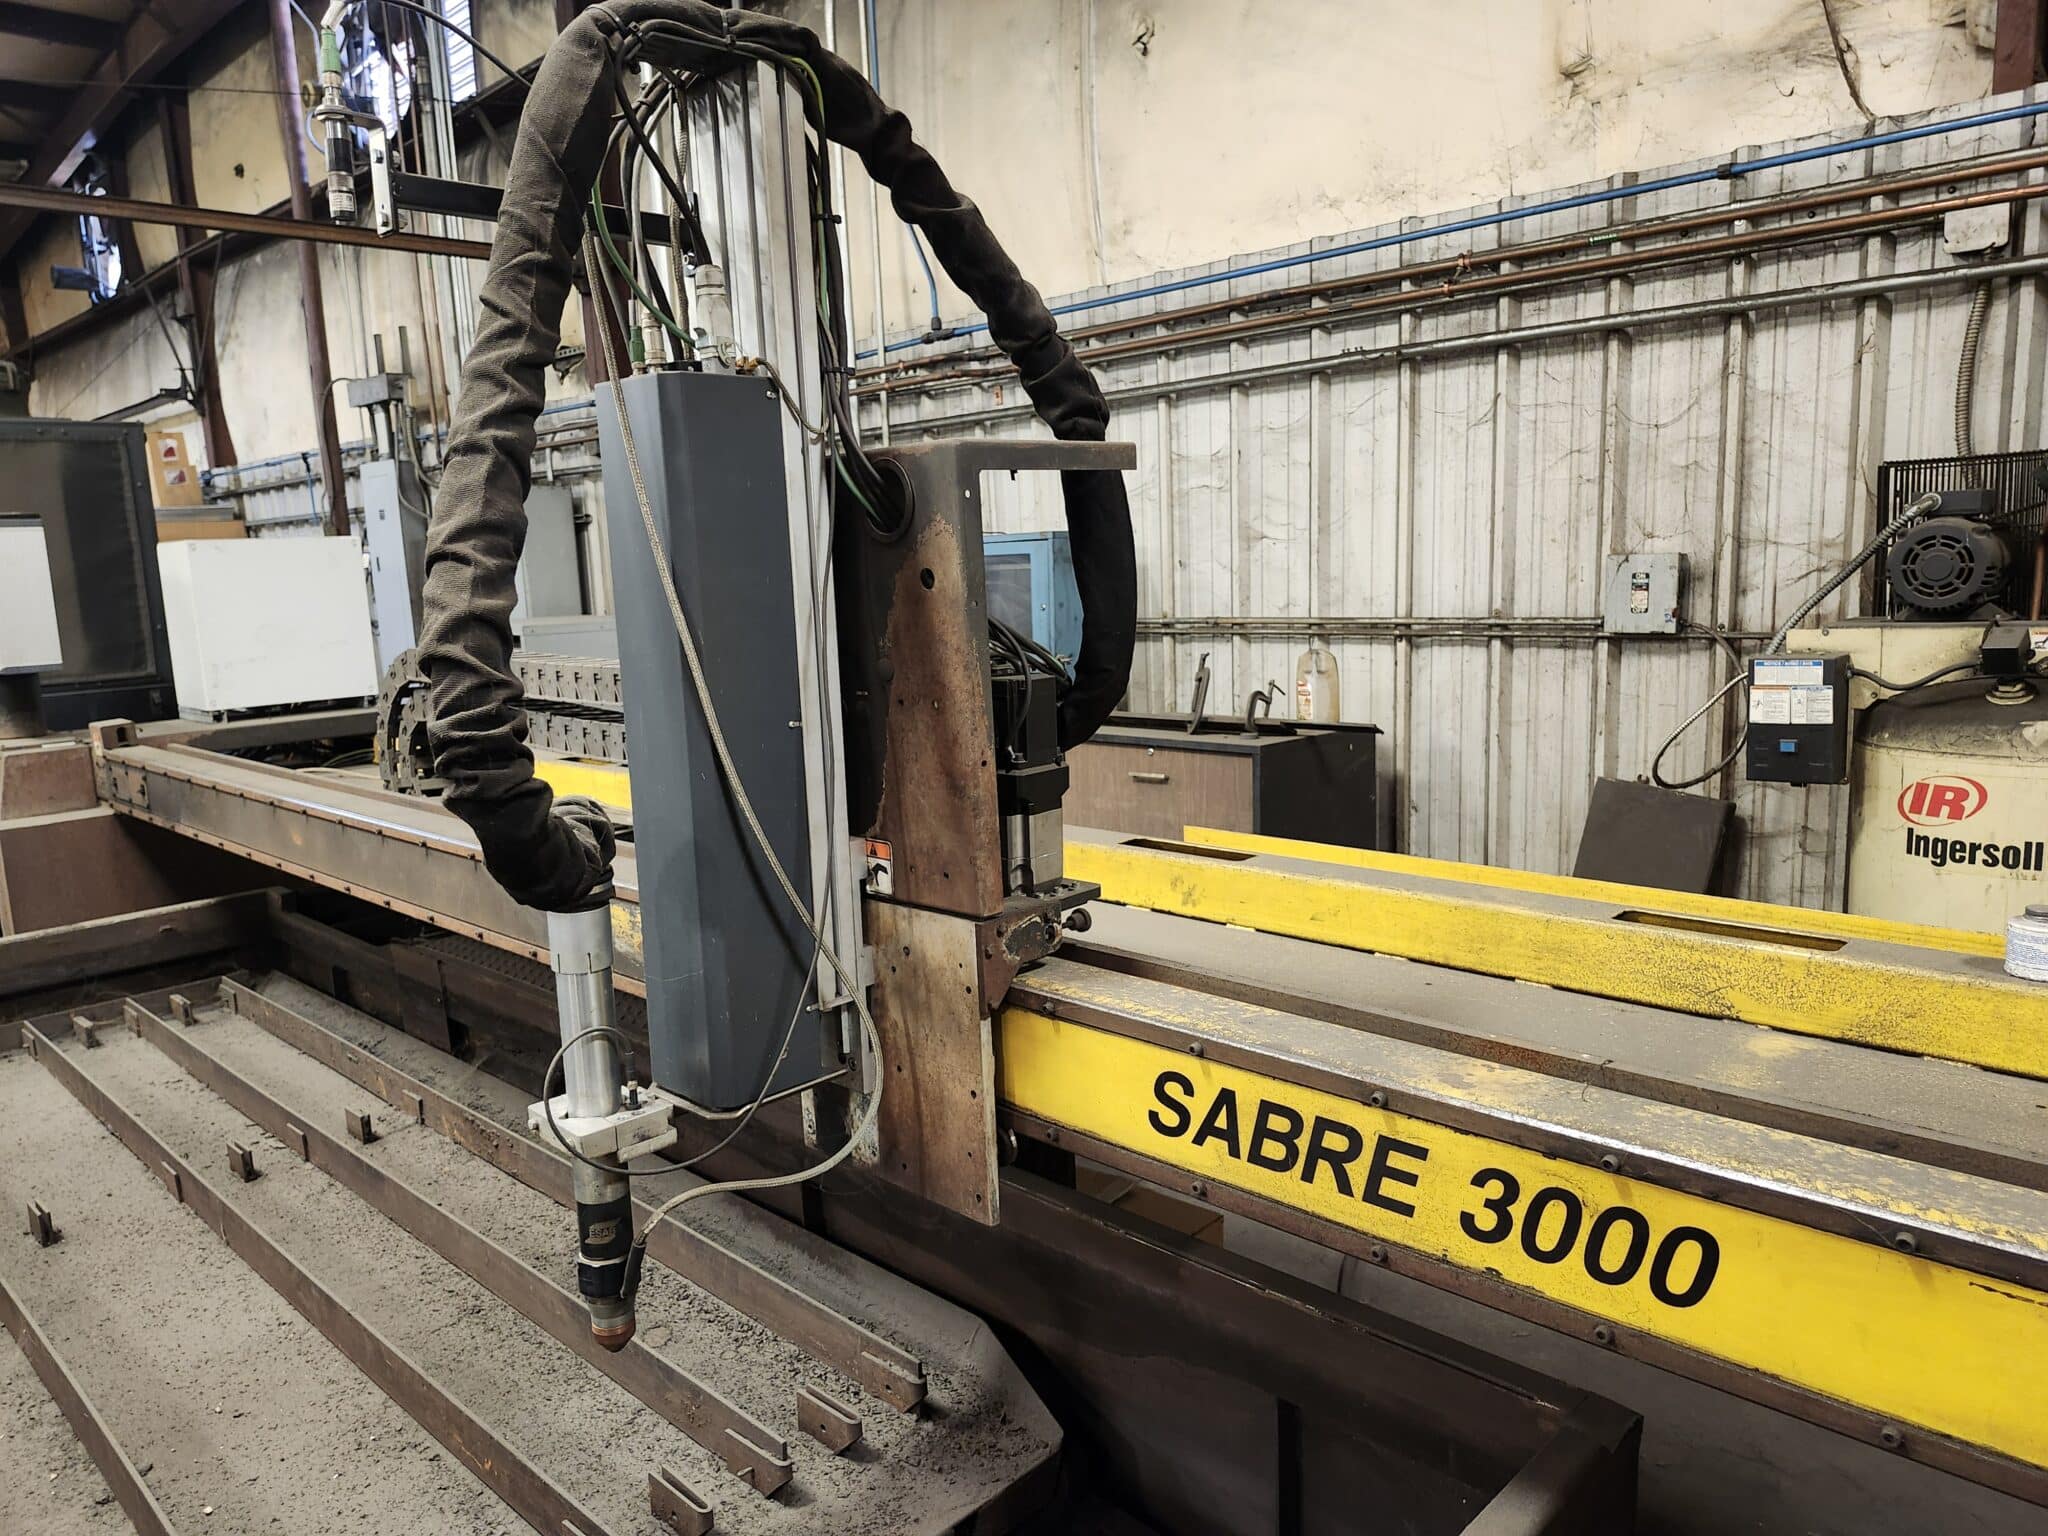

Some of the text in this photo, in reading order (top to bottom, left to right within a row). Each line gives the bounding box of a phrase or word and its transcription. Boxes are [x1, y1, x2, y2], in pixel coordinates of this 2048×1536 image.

[1908, 782, 1970, 821] IR
[1906, 827, 2044, 871] Ingersoll
[1148, 1071, 1720, 1308] SABRE 3000
